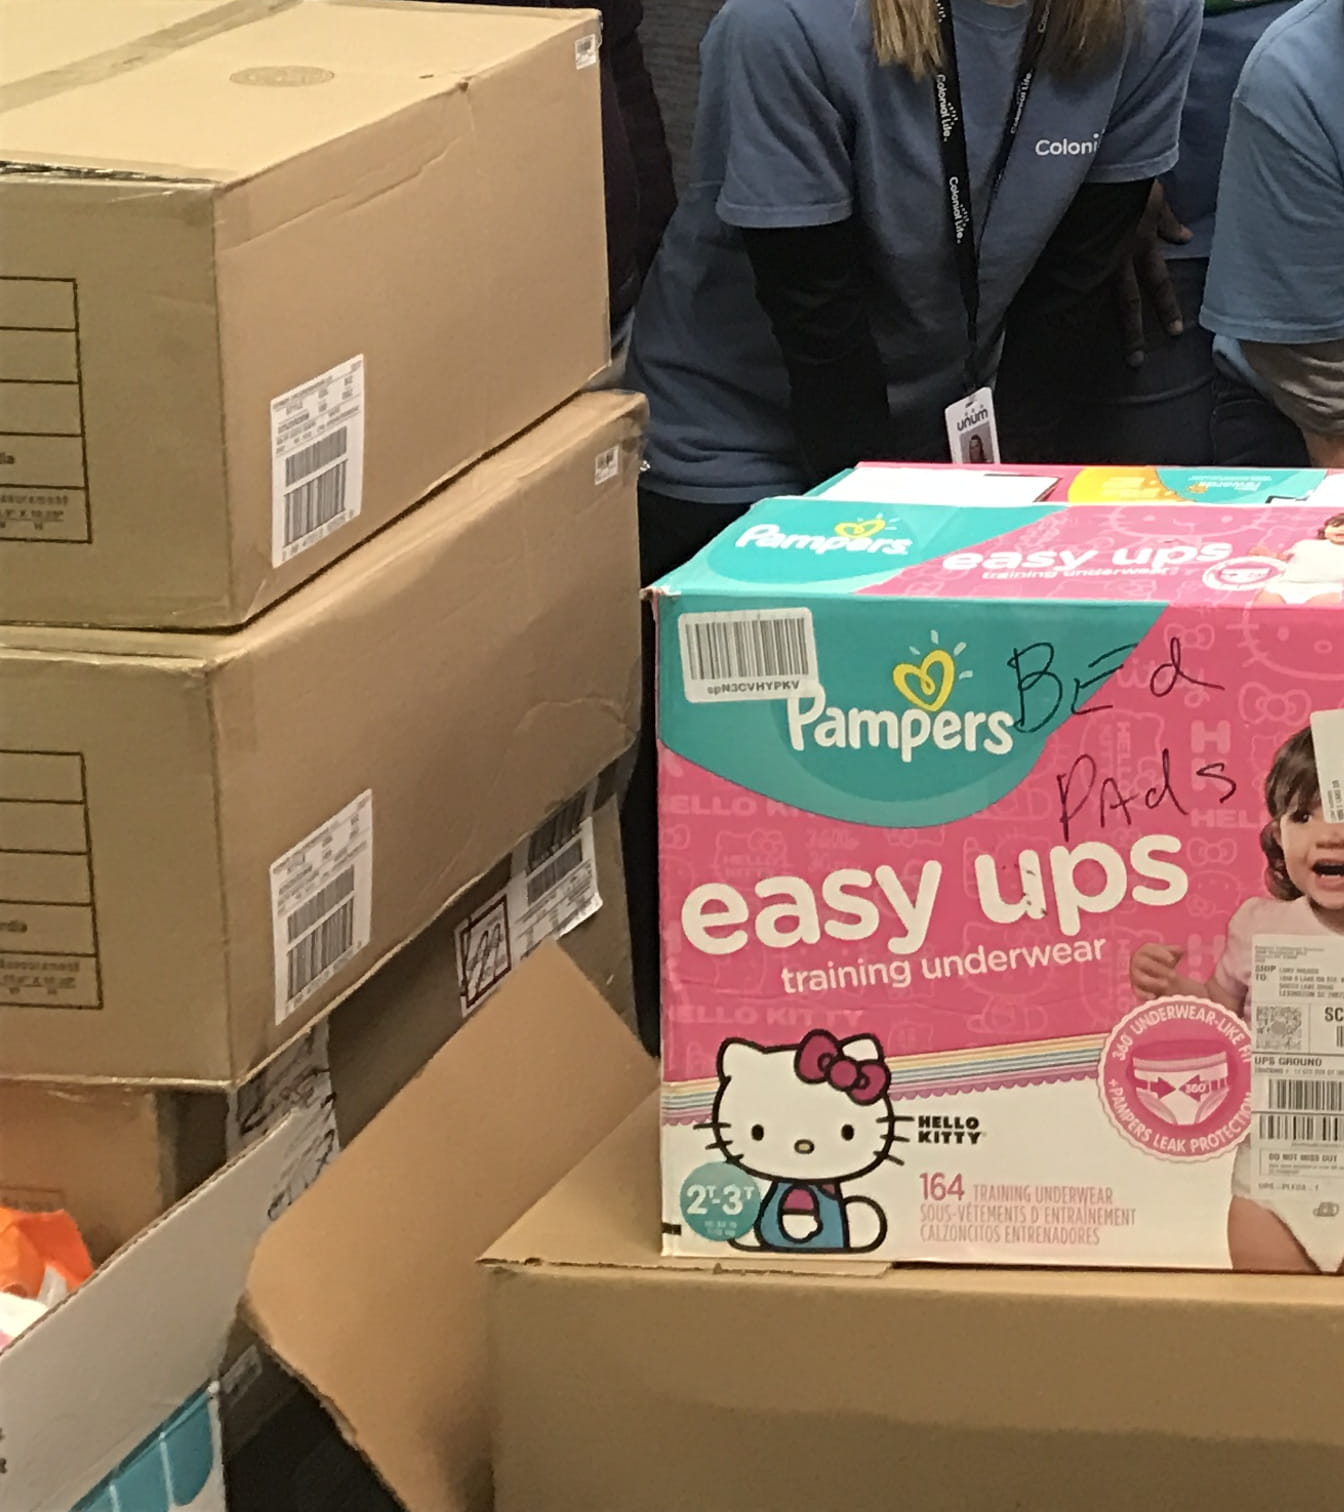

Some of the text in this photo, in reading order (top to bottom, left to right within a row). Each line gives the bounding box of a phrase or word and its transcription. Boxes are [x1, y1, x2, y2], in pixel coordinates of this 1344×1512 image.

[936, 74, 950, 117] Colonial
[1035, 133, 1101, 156] Coloni
[949, 176, 962, 220] Colonial
[956, 406, 989, 432] unum
[736, 523, 913, 556] Pampers
[942, 541, 1233, 573] easy ups
[787, 683, 1014, 763] Pampers
[681, 859, 943, 956] easy
[976, 834, 1189, 936] ups
[781, 937, 1107, 995] training underwear
[1130, 1004, 1245, 1046] UNDERWEAR-LIKE
[1324, 1006, 1344, 1023] SC
[1254, 1056, 1323, 1067] UPS GROUND
[917, 1115, 980, 1129] HELLO
[917, 1131, 983, 1145] KITTY
[1153, 1134, 1186, 1153] LEAK
[919, 1172, 1113, 1204] 164 TRAINING UNDERWEAR
[920, 1225, 1101, 1245] CALZONCITOS ENTRENADORES
